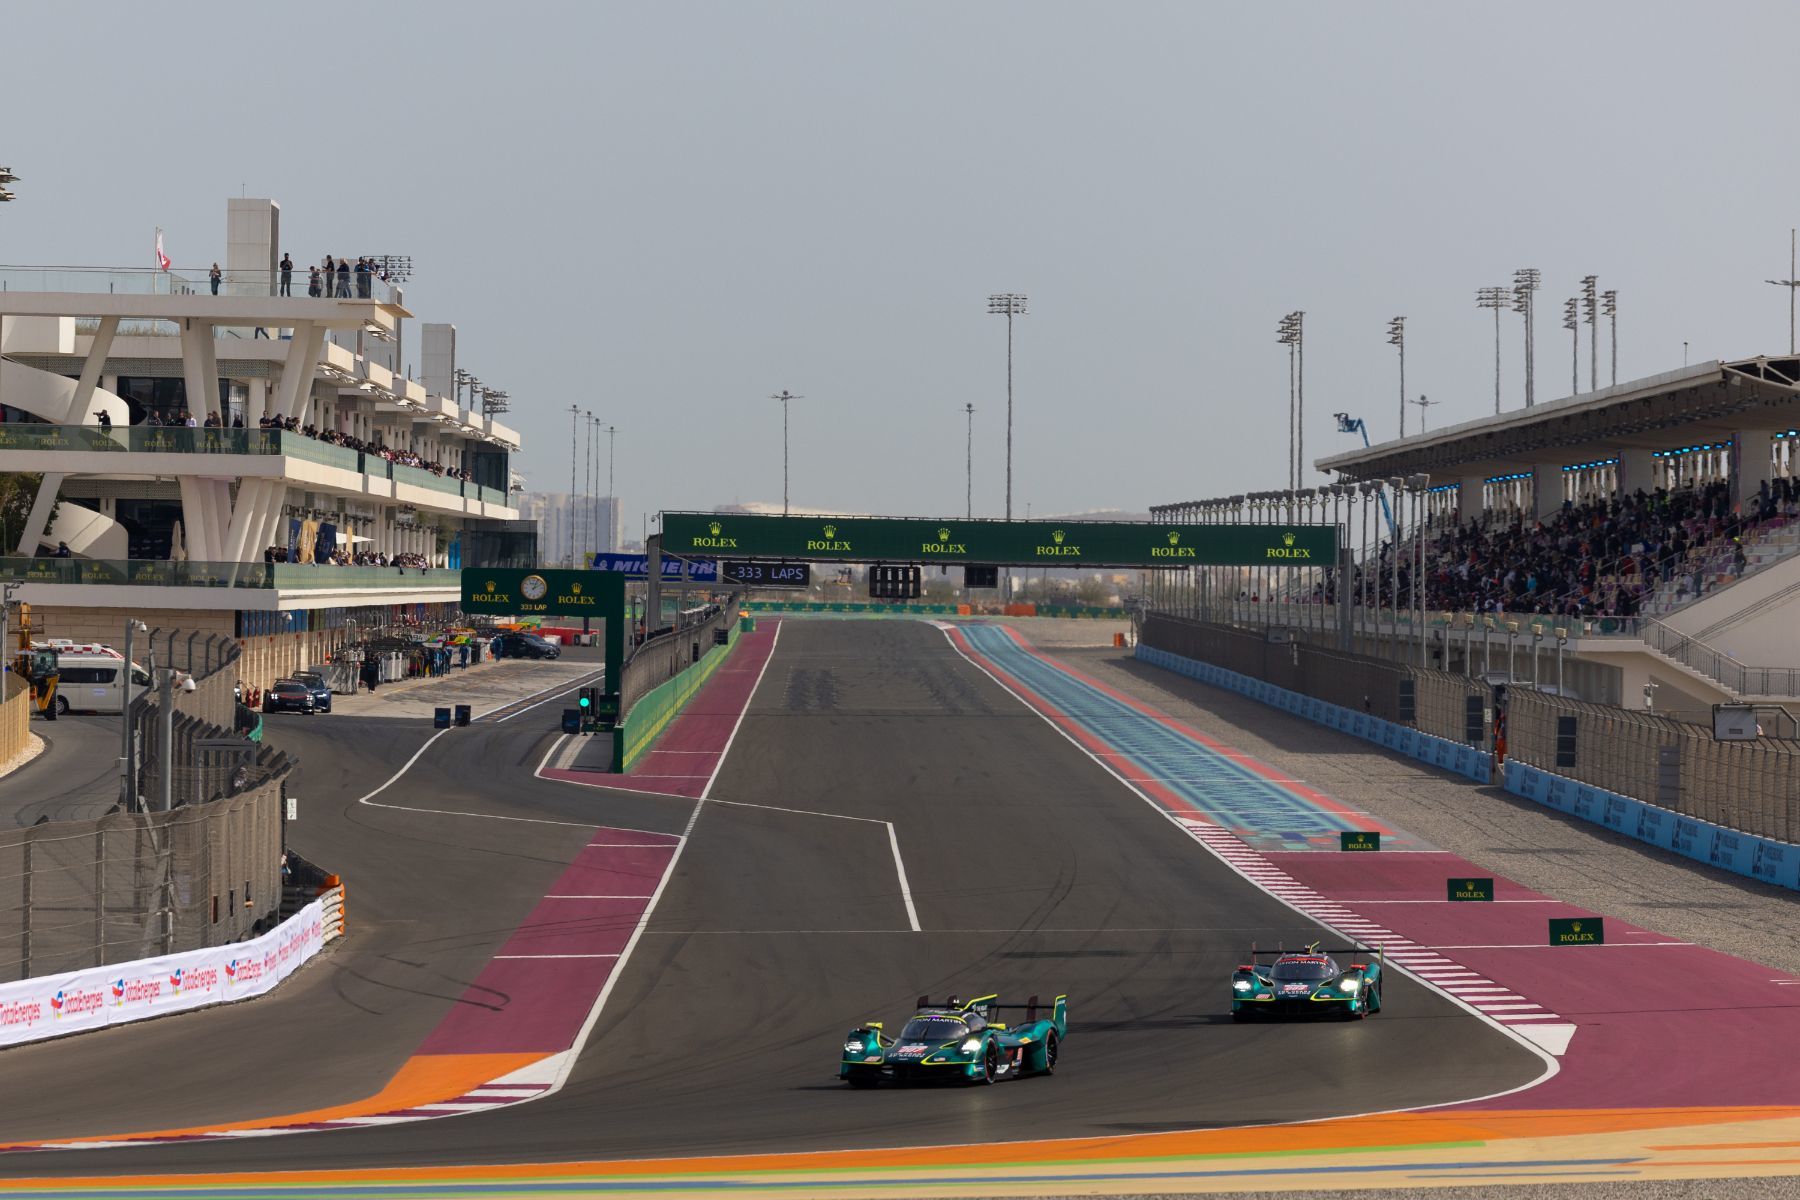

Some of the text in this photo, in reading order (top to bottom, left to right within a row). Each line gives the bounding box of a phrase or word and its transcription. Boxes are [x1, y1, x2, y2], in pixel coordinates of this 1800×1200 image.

[693, 537, 737, 548] ROLEX
[807, 540, 852, 551] ROLEX
[922, 543, 967, 554] ROLEX
[1037, 546, 1081, 556] ROLEX
[1151, 547, 1196, 557] ROLEX
[1267, 548, 1311, 558] ROLEX
[771, 568, 804, 580] LAPS
[472, 594, 510, 603] ROLEX
[558, 595, 596, 605] ROLEX
[1560, 933, 1594, 942] ROLEX
